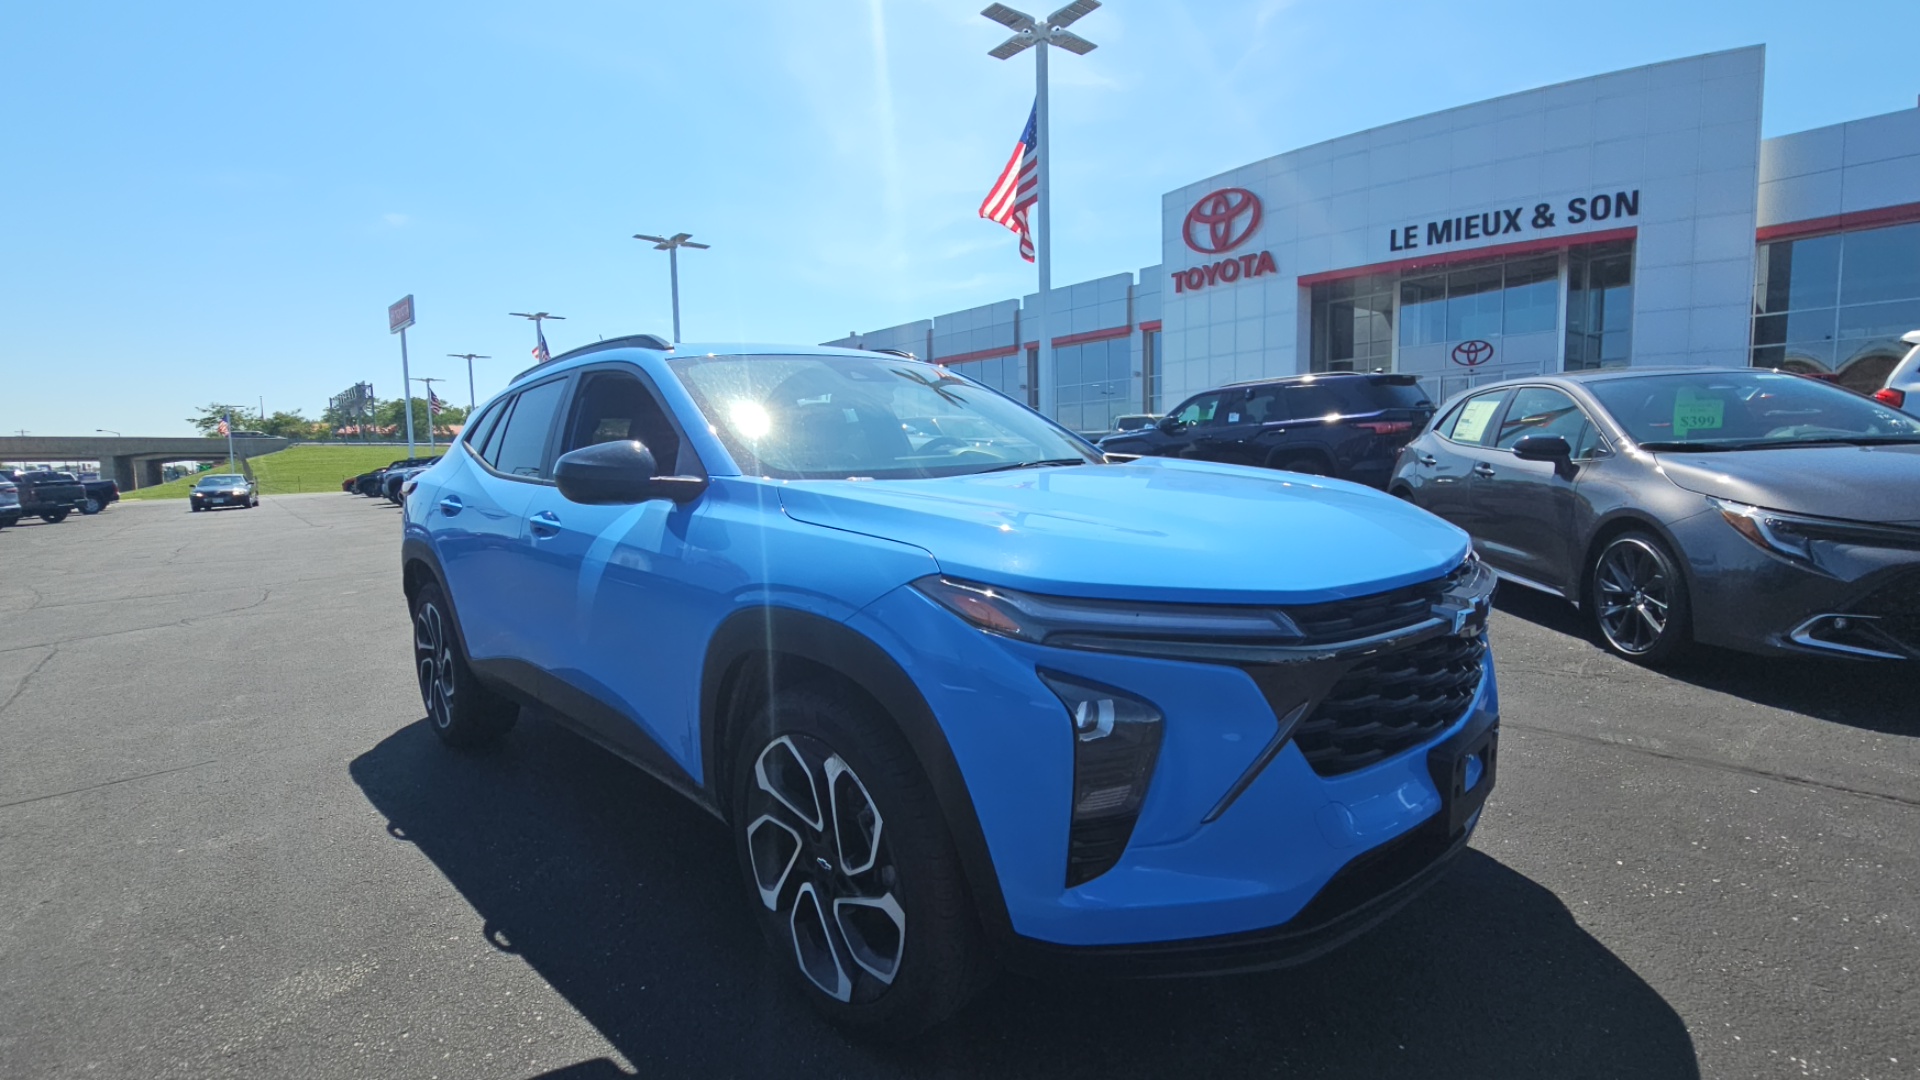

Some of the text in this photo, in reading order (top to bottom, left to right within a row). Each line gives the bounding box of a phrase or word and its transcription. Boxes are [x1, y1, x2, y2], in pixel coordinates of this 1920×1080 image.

[1390, 189, 1640, 251] LE MIEUX & SON
[1171, 250, 1277, 293] TOYOTA
[1680, 416, 1715, 427] $399
